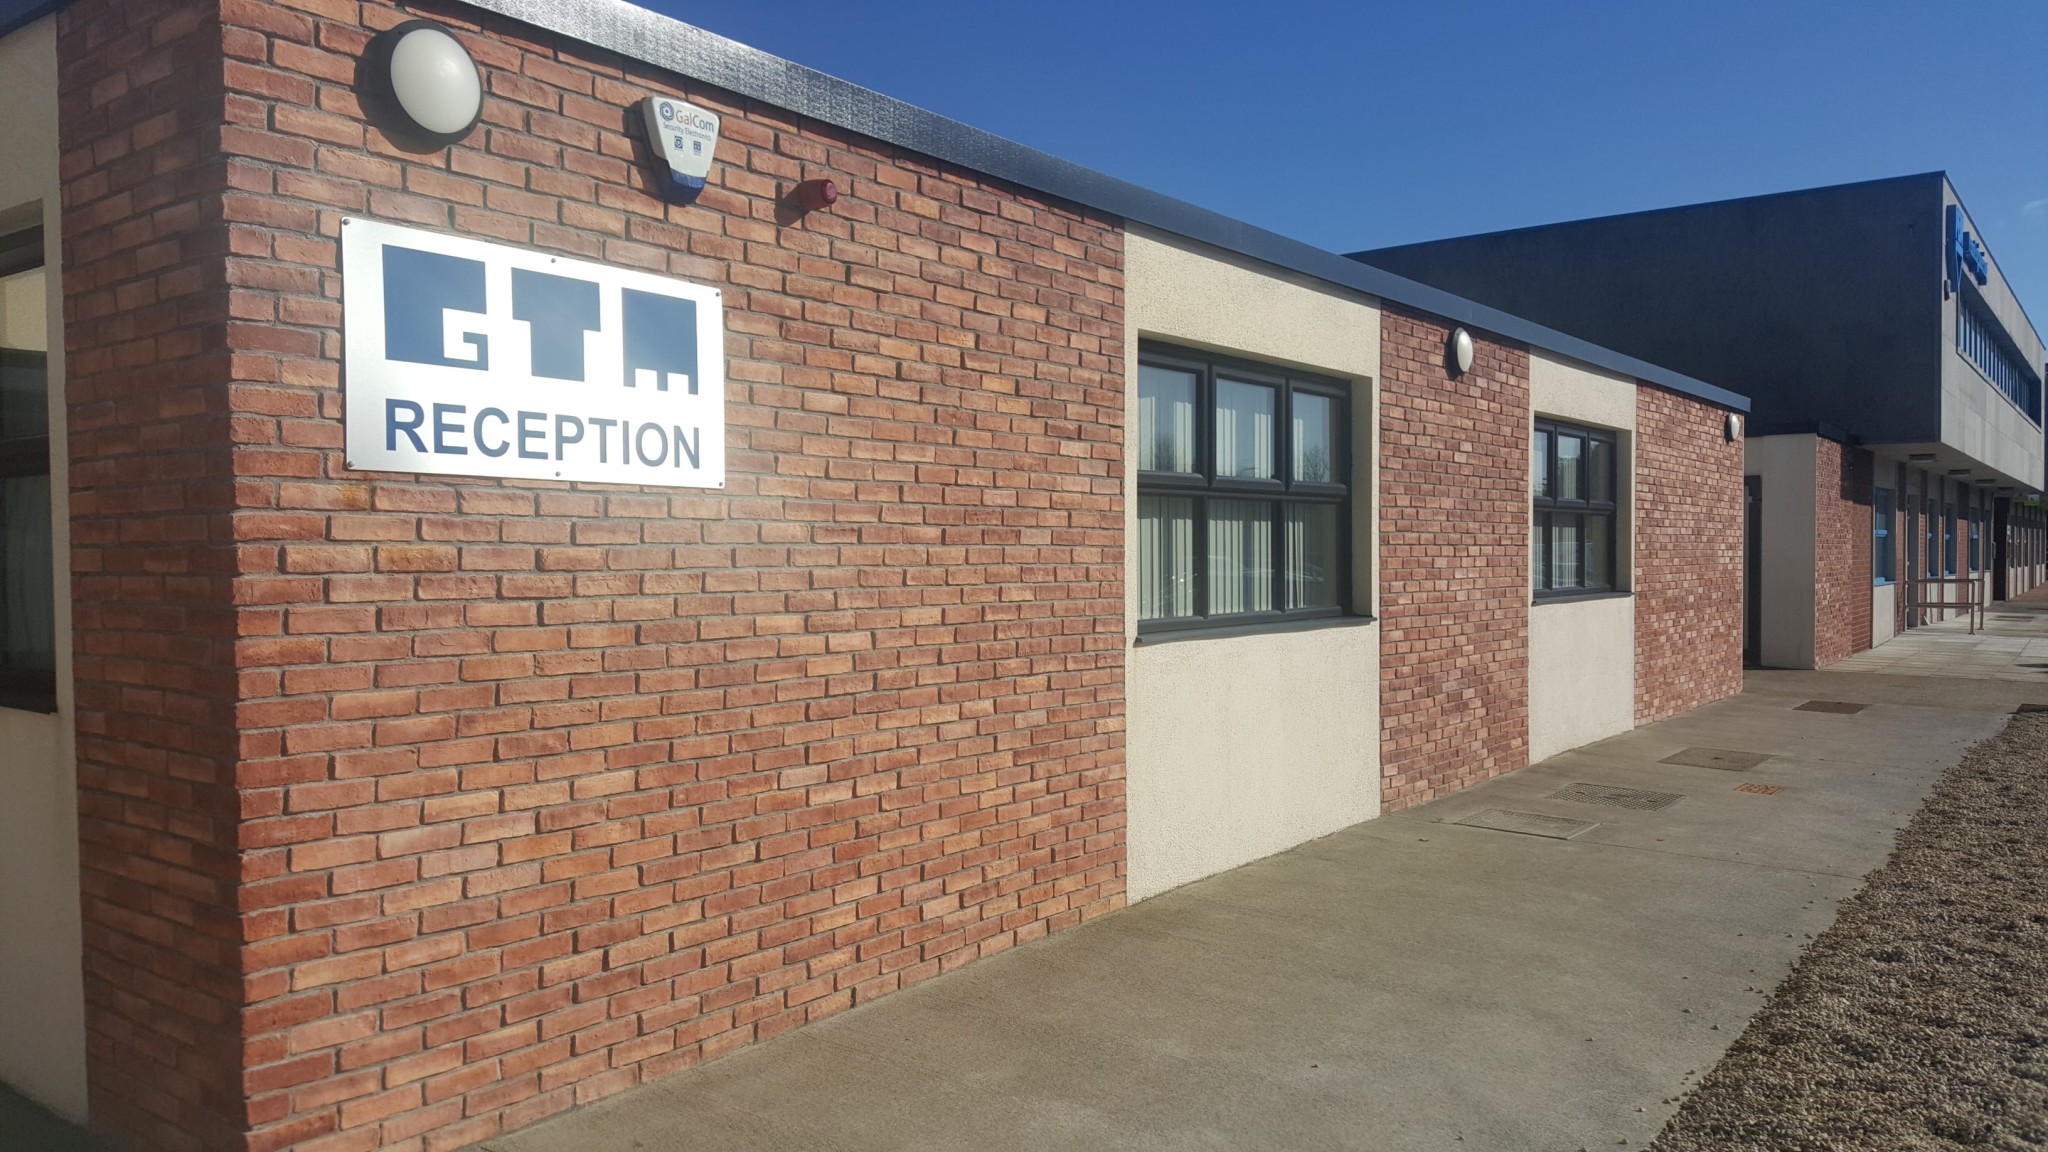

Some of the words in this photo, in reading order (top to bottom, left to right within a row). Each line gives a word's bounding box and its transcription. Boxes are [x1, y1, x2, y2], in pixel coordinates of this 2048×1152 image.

[663, 122, 684, 135] Security
[685, 128, 712, 141] Electronics
[675, 110, 715, 133] GalCom
[385, 398, 700, 470] RECEPTION
